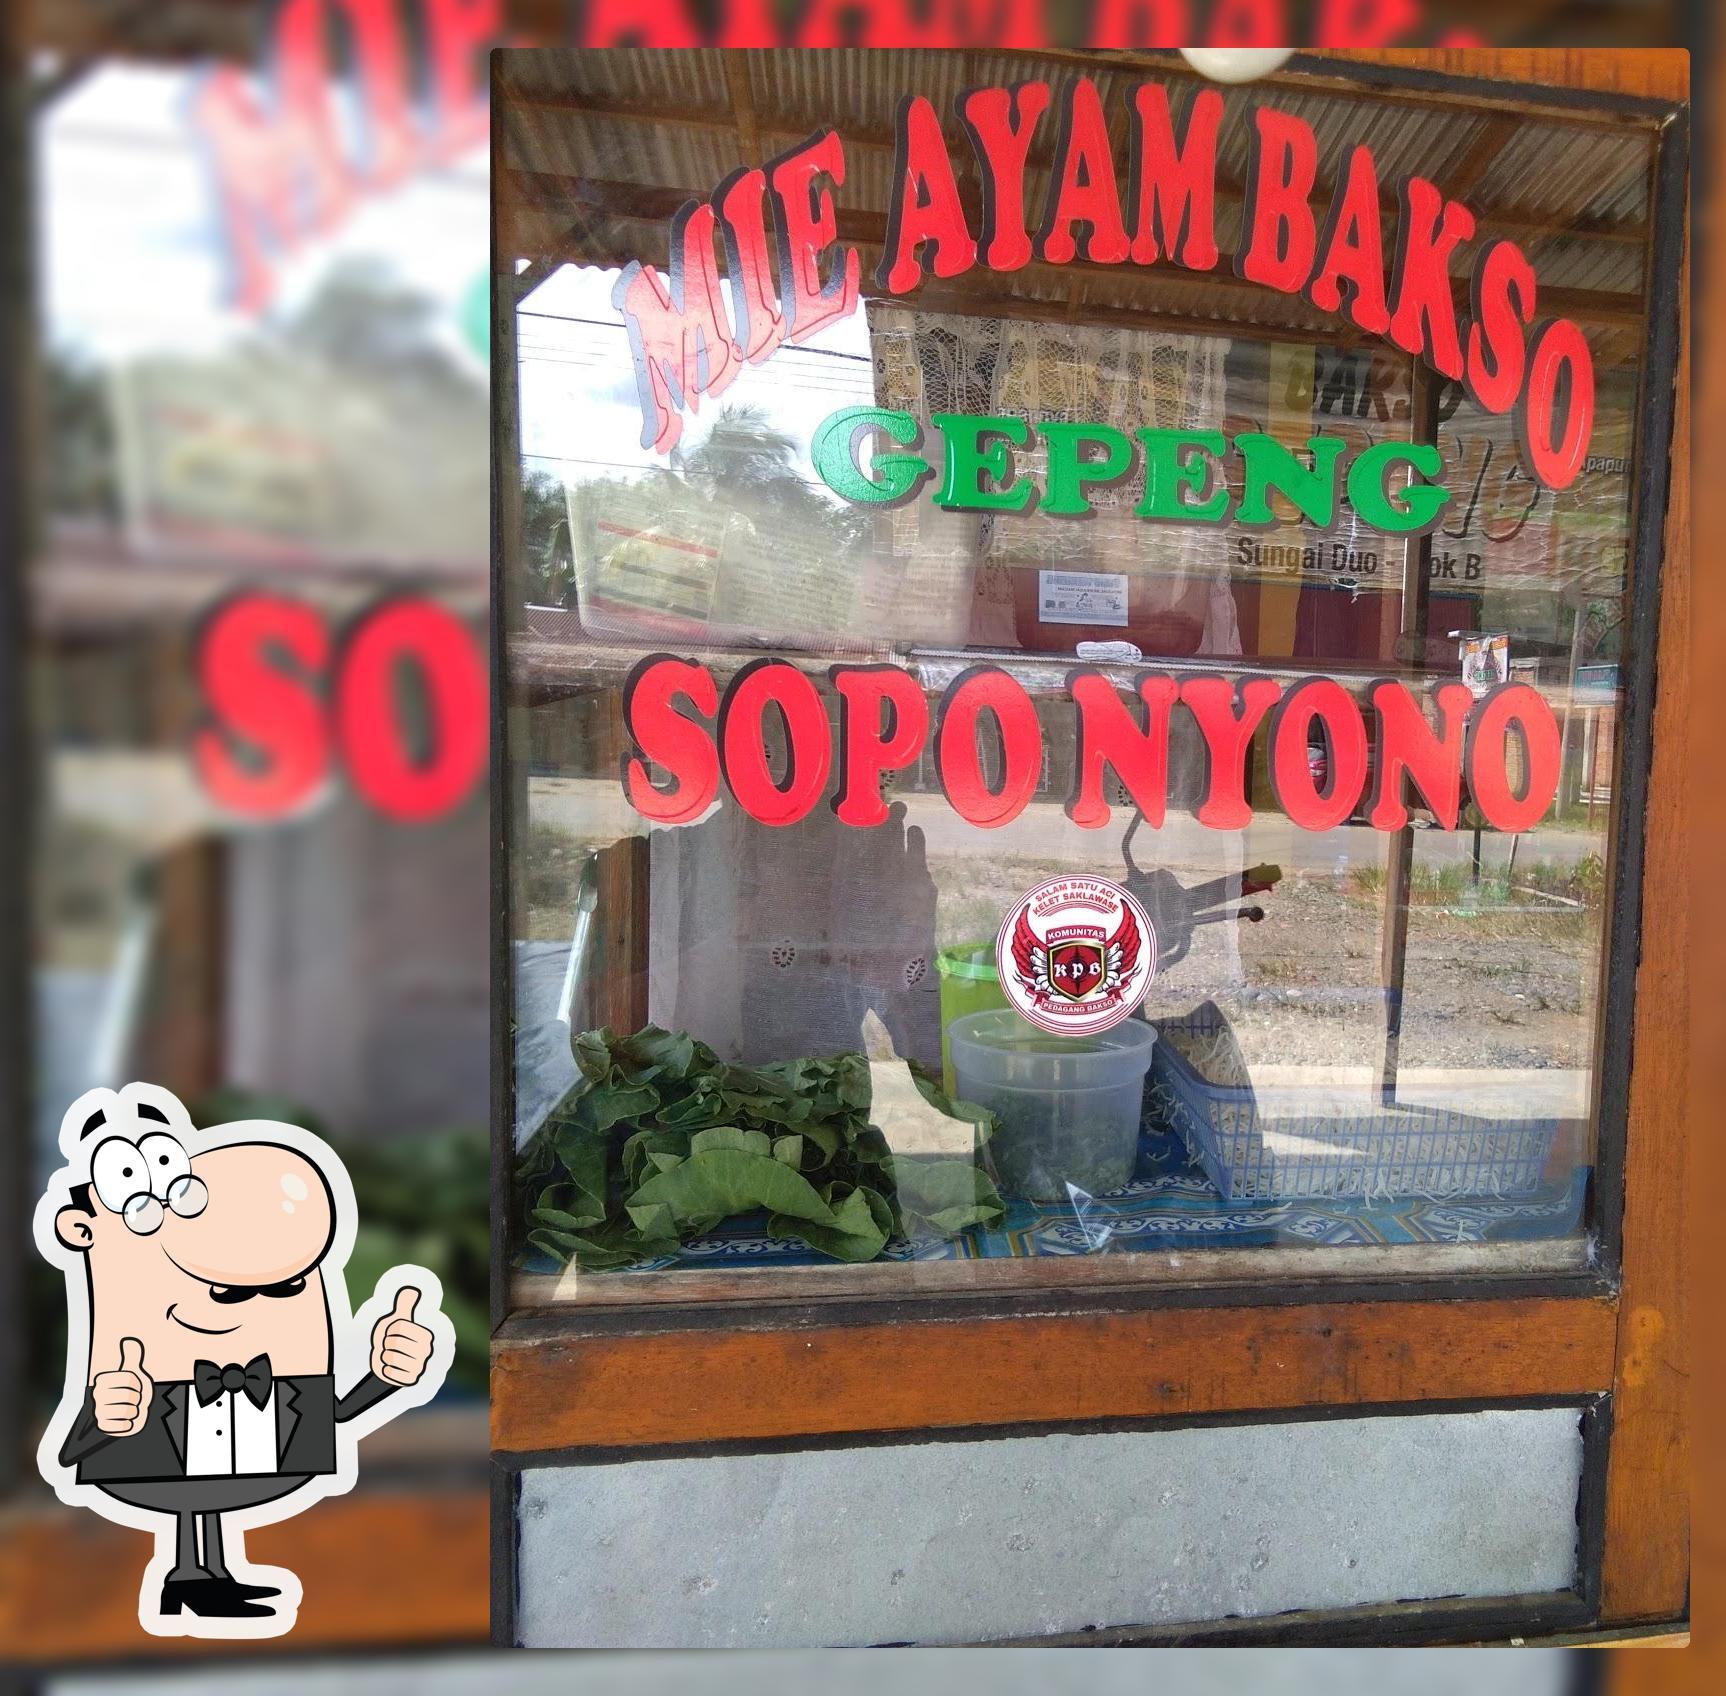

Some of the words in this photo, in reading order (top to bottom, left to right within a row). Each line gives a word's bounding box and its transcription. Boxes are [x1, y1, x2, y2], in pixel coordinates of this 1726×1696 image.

[612, 128, 863, 454] MIE
[877, 78, 1224, 292] AYAM
[1233, 105, 1595, 490] BAKSO
[811, 405, 1456, 533] GEPENG
[1237, 536, 1324, 574] Sungai
[1332, 543, 1377, 574] Duo
[1465, 552, 1482, 580] B
[624, 653, 1042, 828] SOPO
[1064, 670, 1562, 833] NYONO
[1032, 895, 1061, 916] KELET
[1063, 891, 1120, 913] SAKLAWASE
[1035, 883, 1068, 902] SALAM
[1070, 882, 1098, 892] SATU
[1100, 888, 1116, 900] ACI
[1047, 928, 1106, 940] KOMUNITAS
[1043, 1002, 1086, 1013] PEDAGANG
[1087, 999, 1114, 1011] BAKSO
